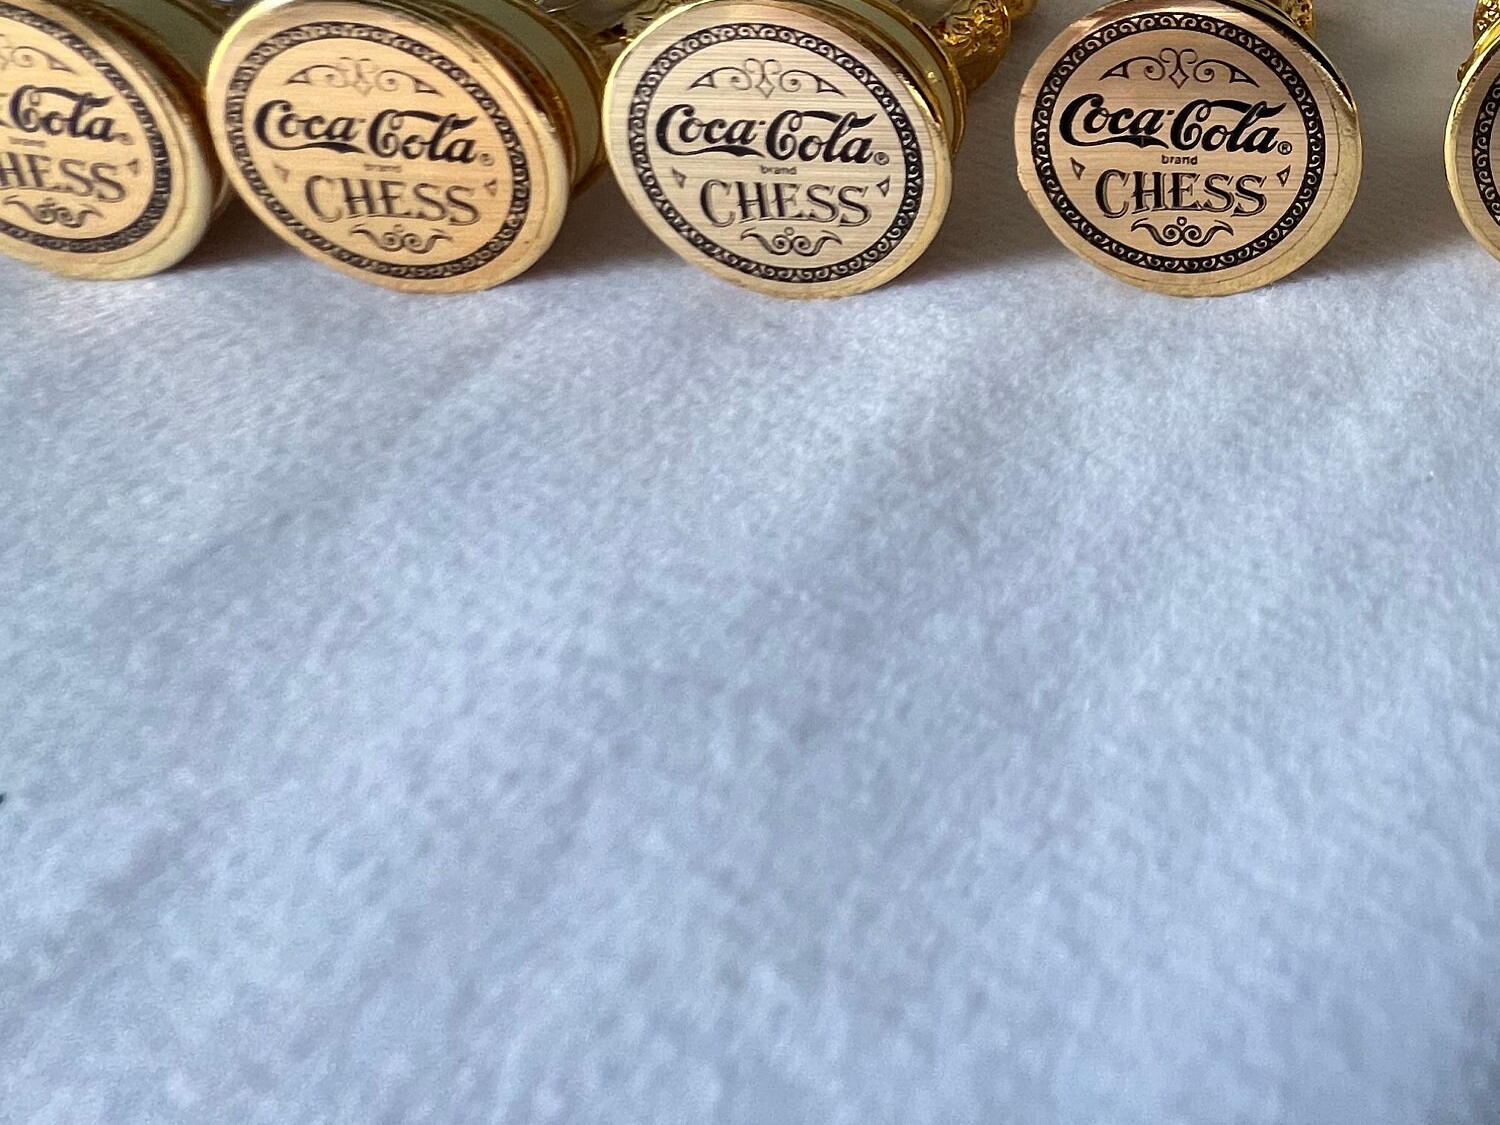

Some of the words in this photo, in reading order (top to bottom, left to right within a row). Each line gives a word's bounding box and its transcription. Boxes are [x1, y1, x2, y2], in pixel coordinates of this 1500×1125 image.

[0, 151, 126, 203] HESS
[1161, 154, 1198, 165] brand
[305, 174, 481, 227] CHESS
[700, 179, 872, 227] CHESS
[1095, 169, 1267, 219] CHESS
